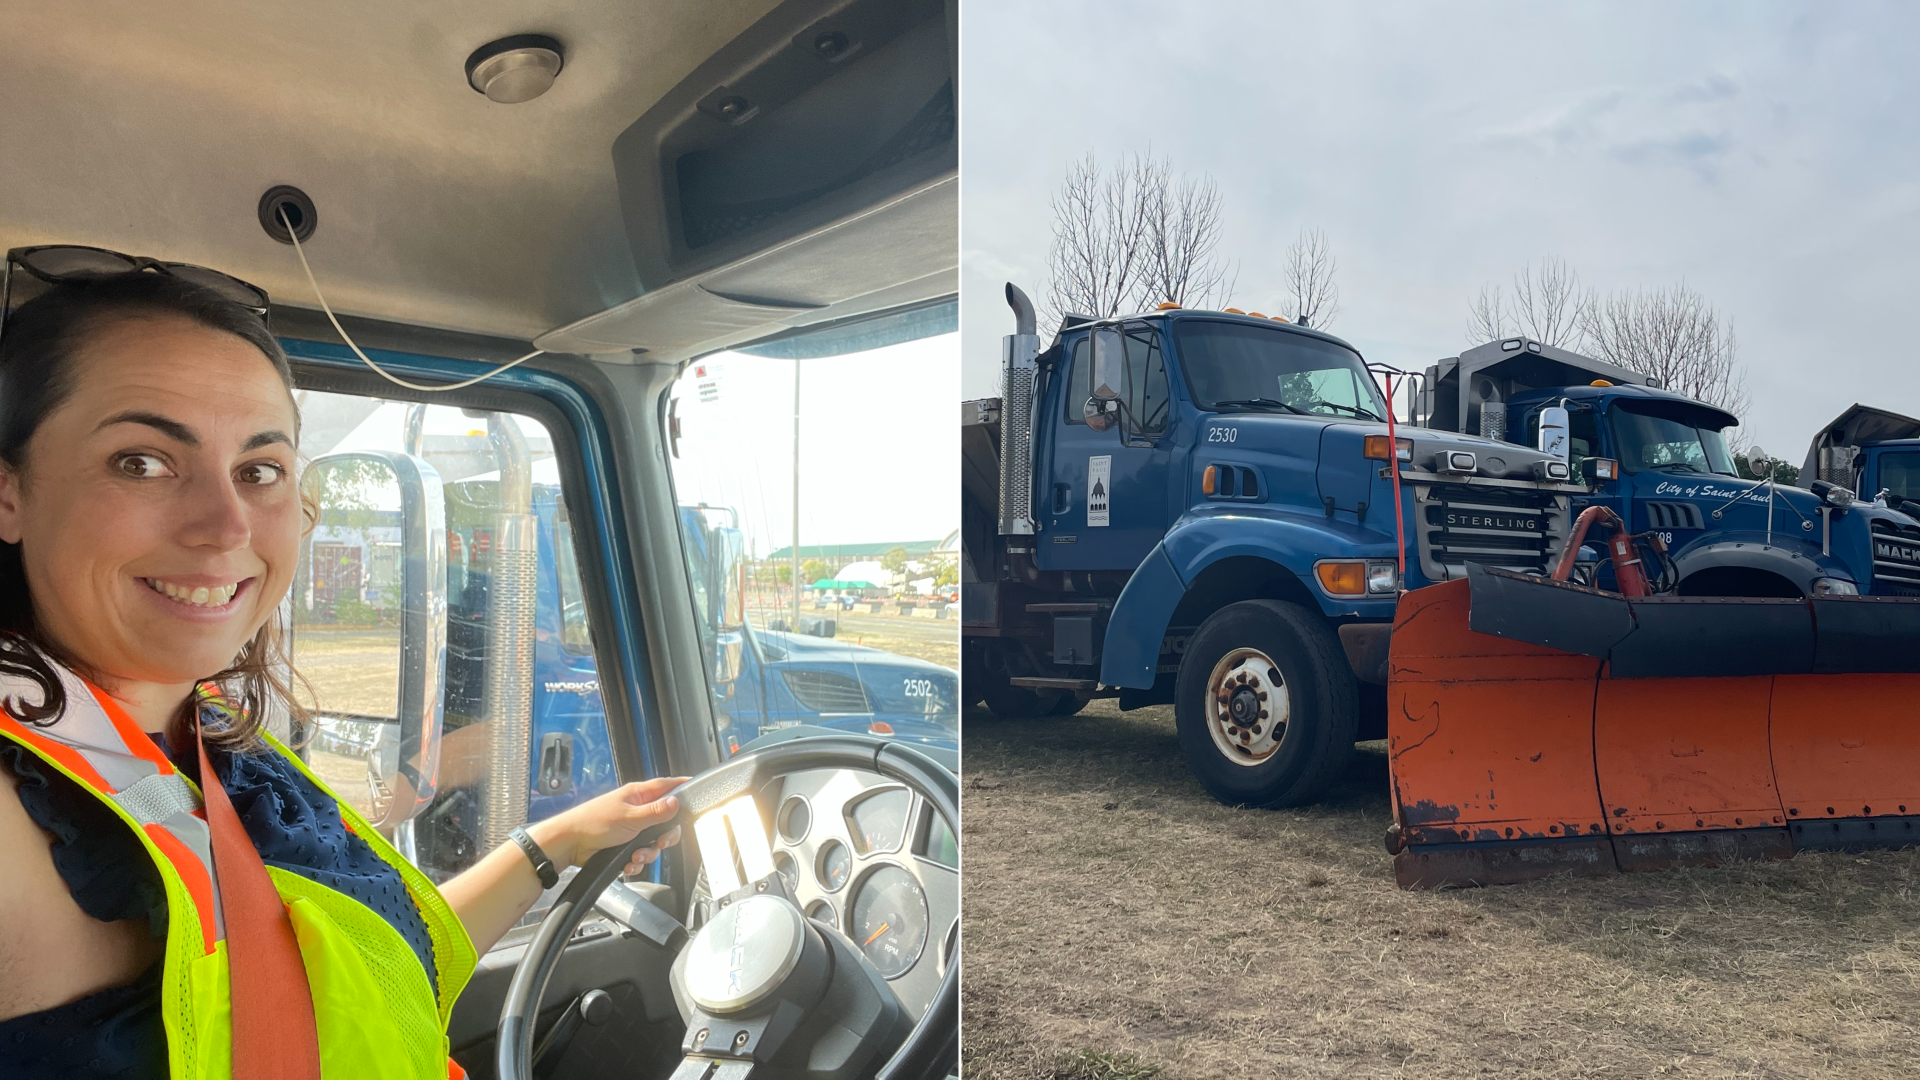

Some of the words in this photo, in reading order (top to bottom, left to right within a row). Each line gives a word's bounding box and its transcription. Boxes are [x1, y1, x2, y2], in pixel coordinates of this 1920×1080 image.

[1208, 427, 1238, 443] 2530
[1655, 481, 1682, 496] City
[1685, 485, 1700, 498] of
[1700, 485, 1738, 499] Saint
[1740, 489, 1771, 503] Paul
[1447, 514, 1536, 529] STERLING
[903, 678, 933, 697] 2502
[912, 886, 919, 894] 14
[884, 943, 899, 956] RPM
